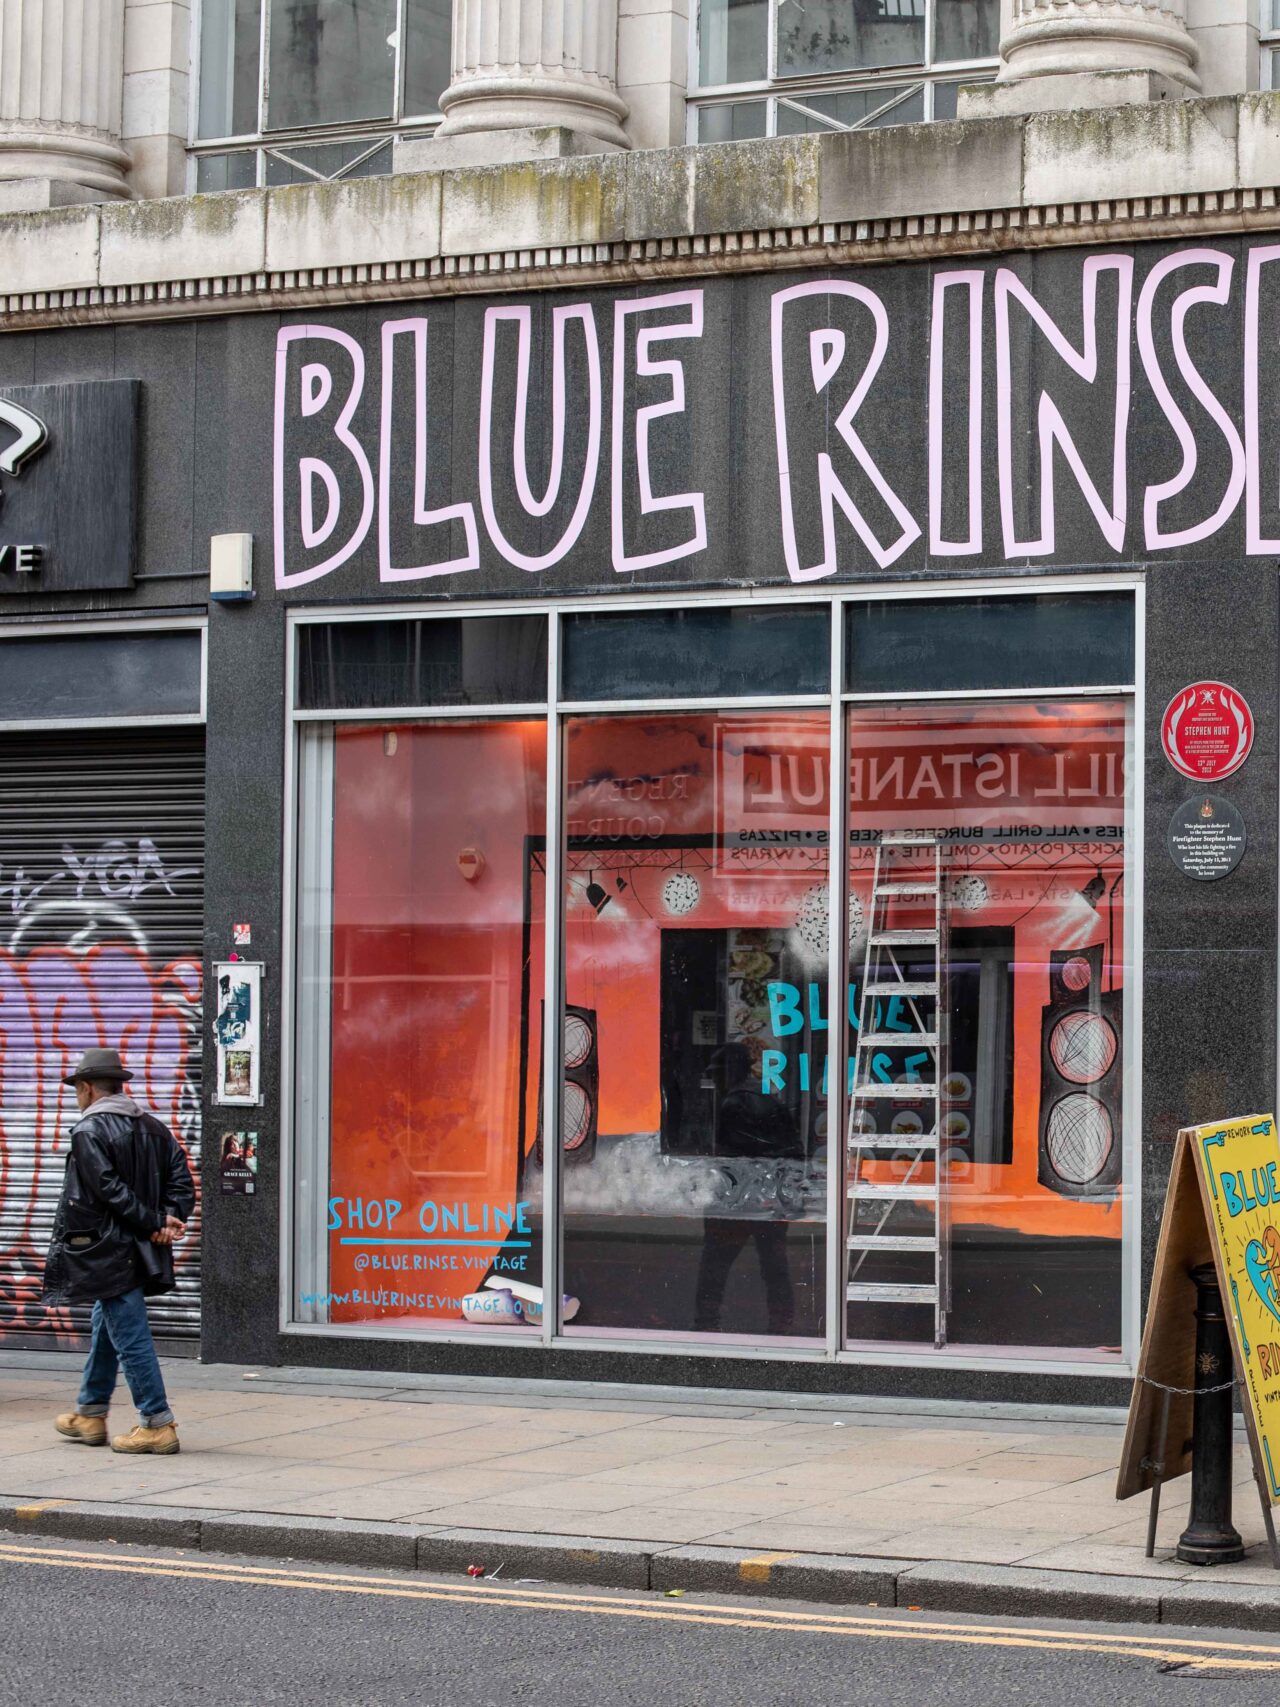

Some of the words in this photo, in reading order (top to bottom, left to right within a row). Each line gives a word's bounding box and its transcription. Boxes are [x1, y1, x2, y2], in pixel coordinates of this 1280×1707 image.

[274, 289, 708, 590] BLUE
[1184, 726, 1212, 736] STEPHEN
[1213, 726, 1230, 736] HUNT
[1227, 1125, 1251, 1139] REWORK
[327, 1196, 402, 1231] SHOP
[419, 1200, 532, 1234] ONLINE
